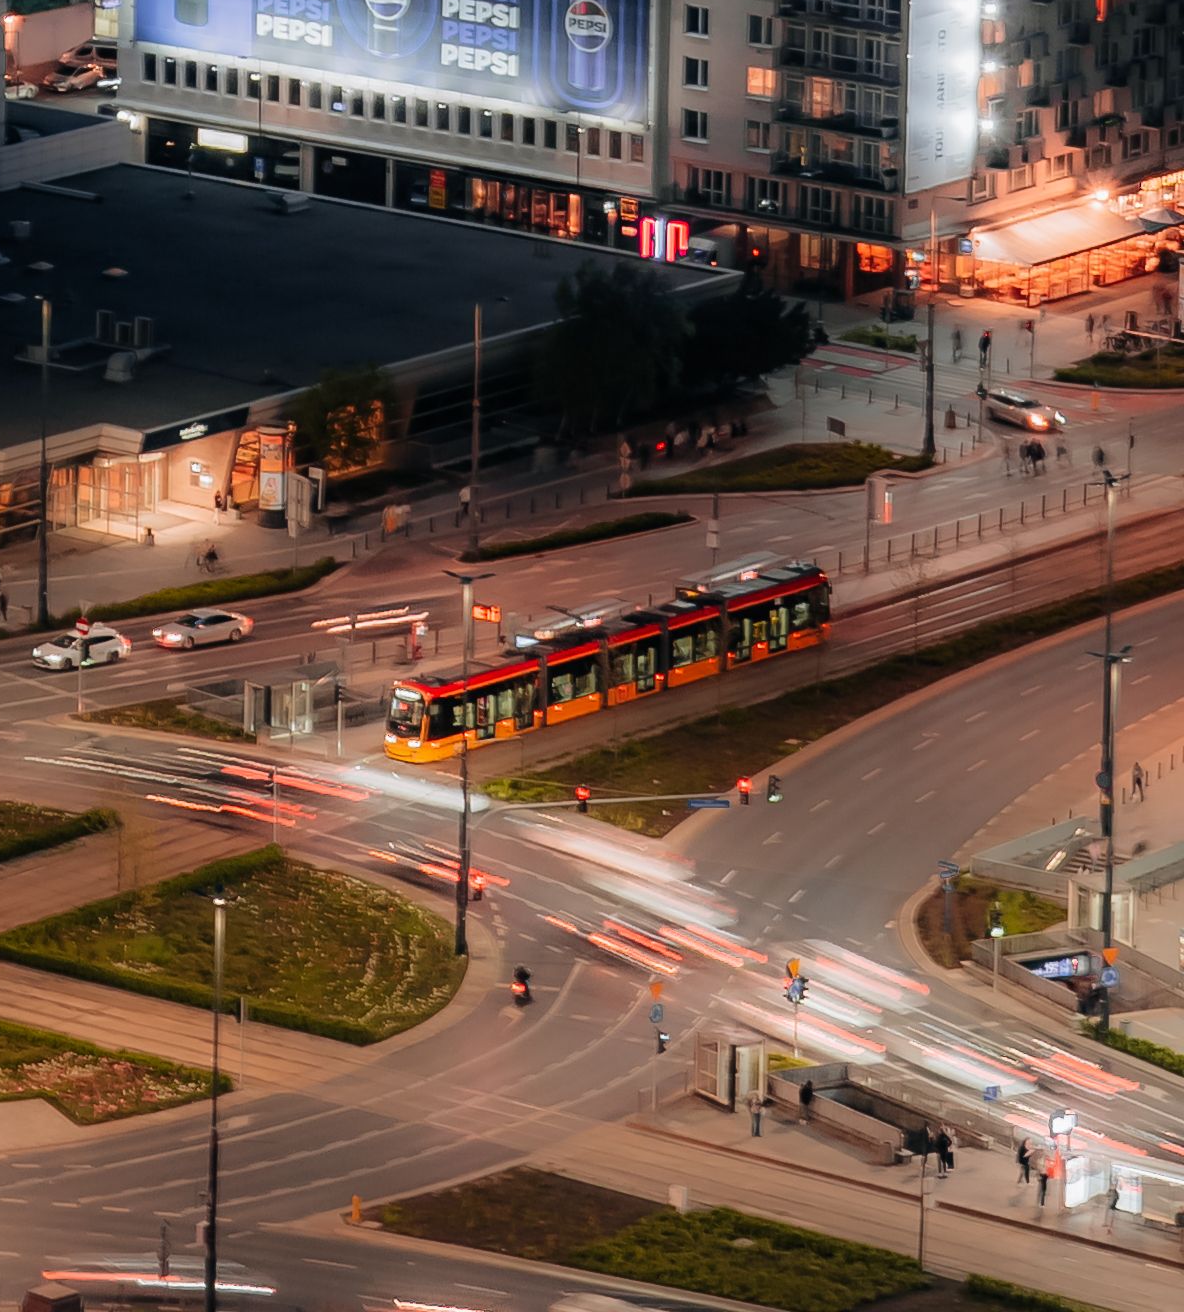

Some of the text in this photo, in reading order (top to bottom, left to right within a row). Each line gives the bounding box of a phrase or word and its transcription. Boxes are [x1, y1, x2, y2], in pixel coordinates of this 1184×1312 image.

[256, 13, 333, 47] PEPSI
[442, 20, 519, 52] PEPSI
[569, 17, 607, 34] PEPSI
[441, 43, 519, 77] PEPSI
